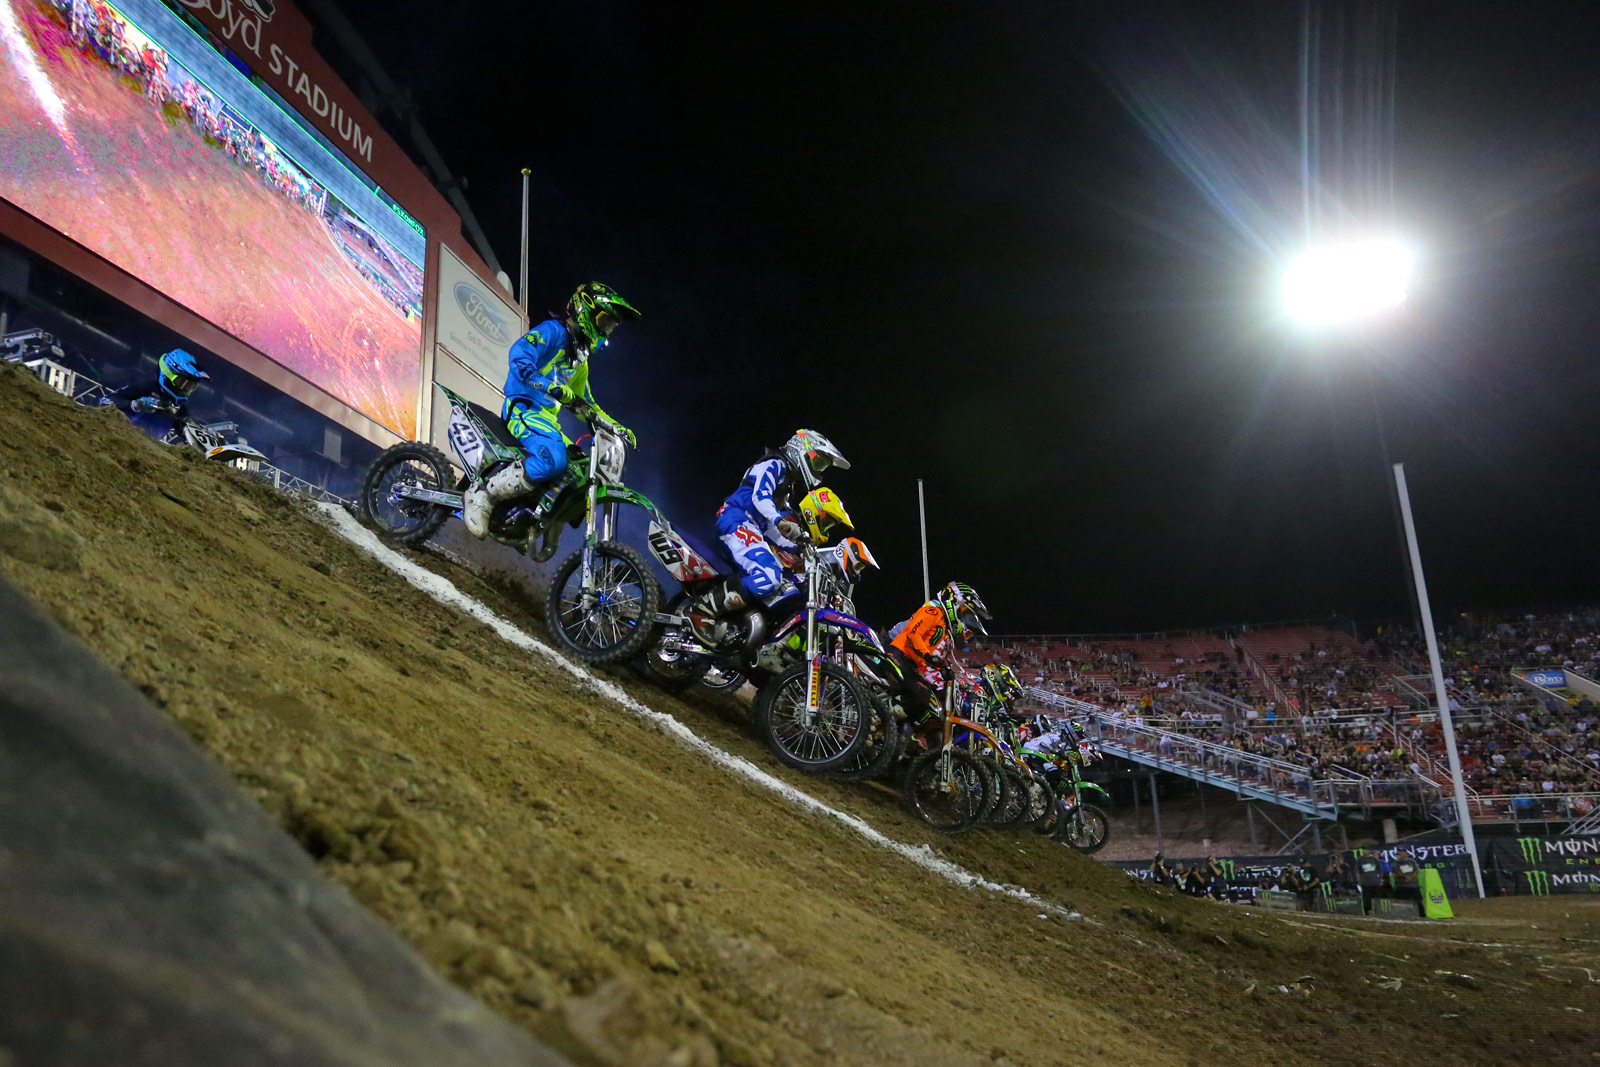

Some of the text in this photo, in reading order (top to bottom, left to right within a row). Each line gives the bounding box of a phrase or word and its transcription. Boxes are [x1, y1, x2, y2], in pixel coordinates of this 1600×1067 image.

[268, 43, 373, 162] STADIUM
[465, 292, 502, 340] Ford
[452, 422, 477, 453] 431
[649, 531, 683, 565] 109
